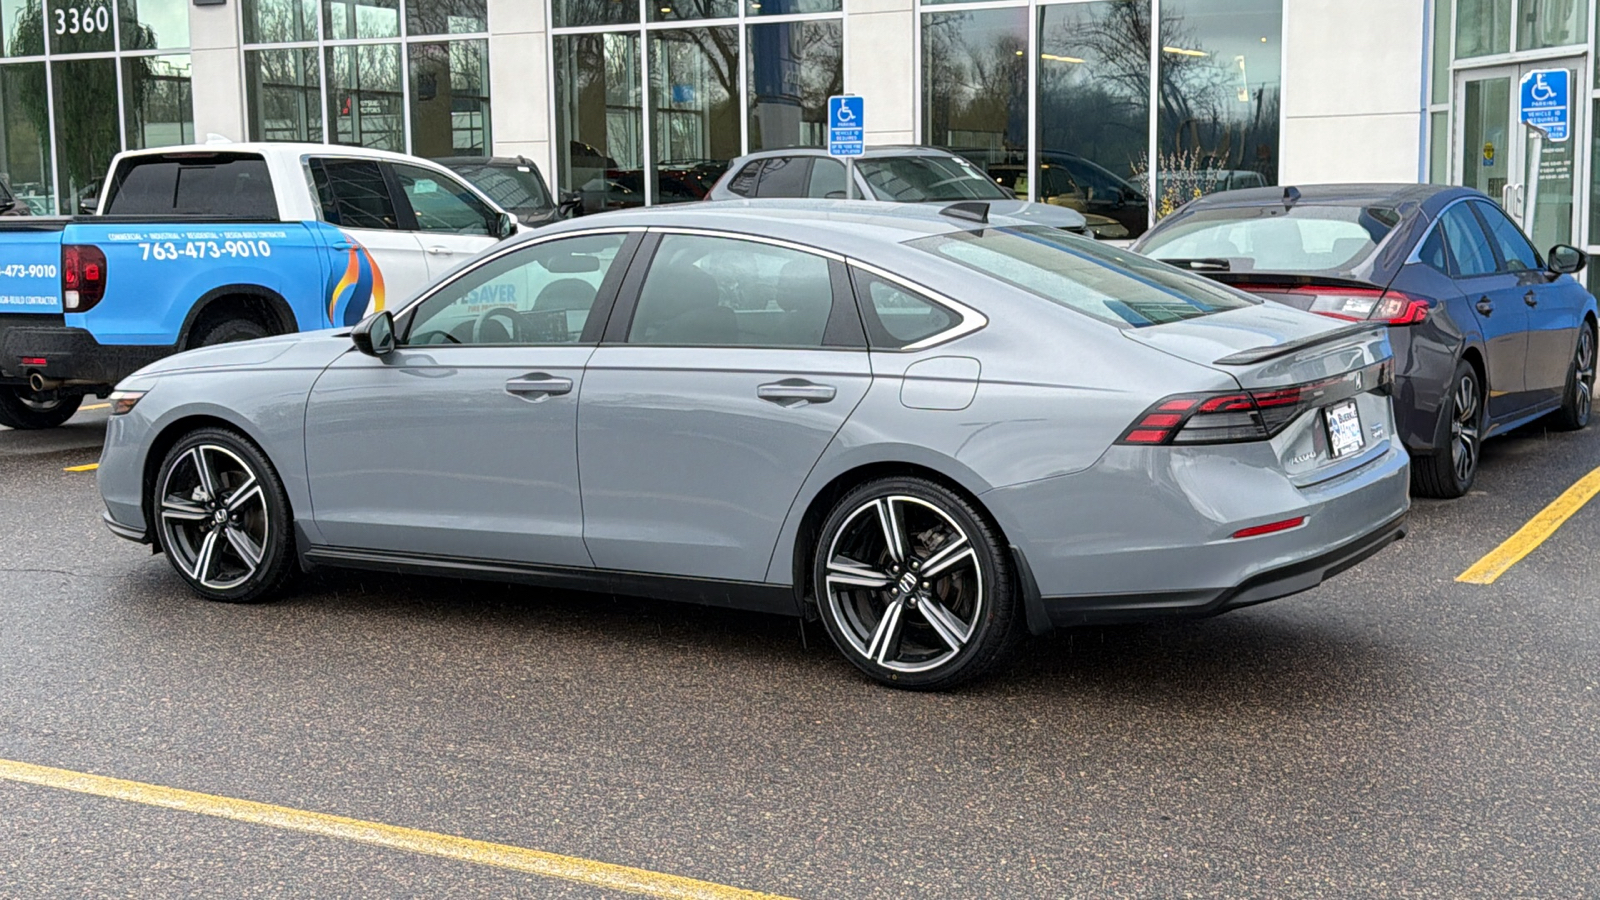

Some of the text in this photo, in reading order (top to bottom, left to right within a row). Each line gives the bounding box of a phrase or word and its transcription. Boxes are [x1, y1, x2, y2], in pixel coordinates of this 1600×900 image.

[54, 5, 109, 35] 3360
[107, 233, 143, 242] COMMERCIAL
[149, 232, 180, 240] INDUSTRIAL
[186, 232, 219, 240] RESIDENTIAL
[138, 240, 271, 261] 763-473-9010
[0, 264, 57, 278] -473-9010
[25, 296, 58, 305] CONTRACTOR
